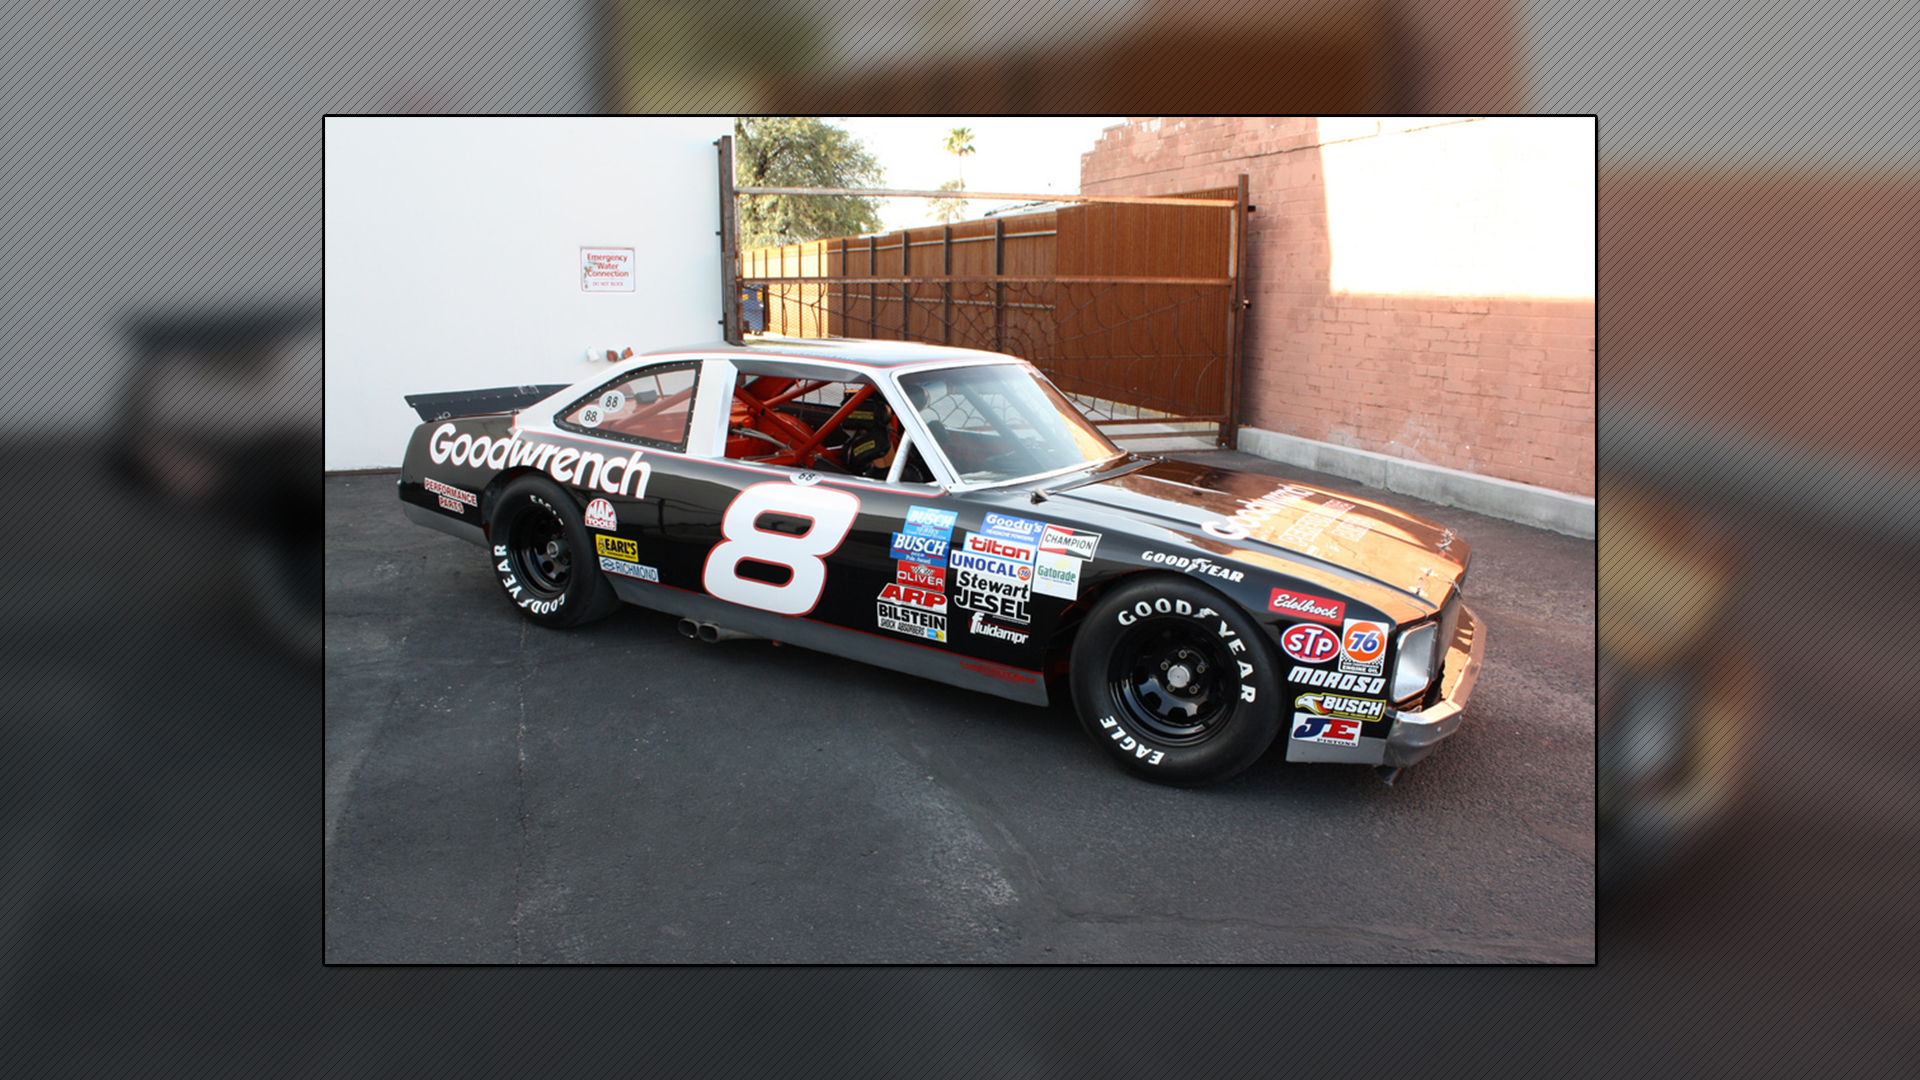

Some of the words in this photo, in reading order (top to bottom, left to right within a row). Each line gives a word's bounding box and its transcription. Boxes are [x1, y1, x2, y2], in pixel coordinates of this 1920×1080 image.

[587, 253, 628, 262] Emergency
[597, 262, 619, 270] Water
[587, 270, 629, 278] Connection
[605, 395, 619, 408] 88
[584, 410, 598, 422] 88
[429, 422, 651, 500] Goodwrench
[424, 477, 478, 507] PERFORMANCE
[438, 494, 464, 514] PARTS
[587, 500, 615, 520] MAC
[907, 510, 955, 528] BUSCH
[986, 513, 1044, 534] Goody's
[604, 538, 637, 555] EARL'S
[702, 481, 861, 617] 8
[893, 533, 948, 557] BUSCH
[969, 537, 1031, 560] tilton
[1045, 533, 1093, 550] CHAMPION
[615, 561, 657, 581] RICHMOND
[952, 553, 1017, 578] UNOCAL
[1019, 568, 1029, 578] 76
[1037, 564, 1076, 583] Gatorade
[1141, 550, 1245, 583] GOODYEAR
[897, 570, 944, 587] OLIVER
[958, 570, 1029, 600] Stewart
[880, 584, 947, 608] ARP
[955, 588, 1030, 622] JESEL
[1273, 593, 1340, 619] Edelbrock
[878, 603, 946, 631] BILSTEIN
[880, 617, 896, 629] SHOCK
[897, 621, 925, 637] ABSORBERS
[969, 611, 1030, 645] fluidampr
[1117, 598, 1256, 704] GOODYEAR
[1287, 627, 1333, 658] STP
[1347, 630, 1381, 653] 76
[1287, 665, 1387, 695] MOROSO
[1322, 695, 1383, 716] BUSCH
[1099, 714, 1165, 766] EAGLE
[1293, 717, 1360, 741] JE
[1316, 738, 1356, 746] PISTONS
